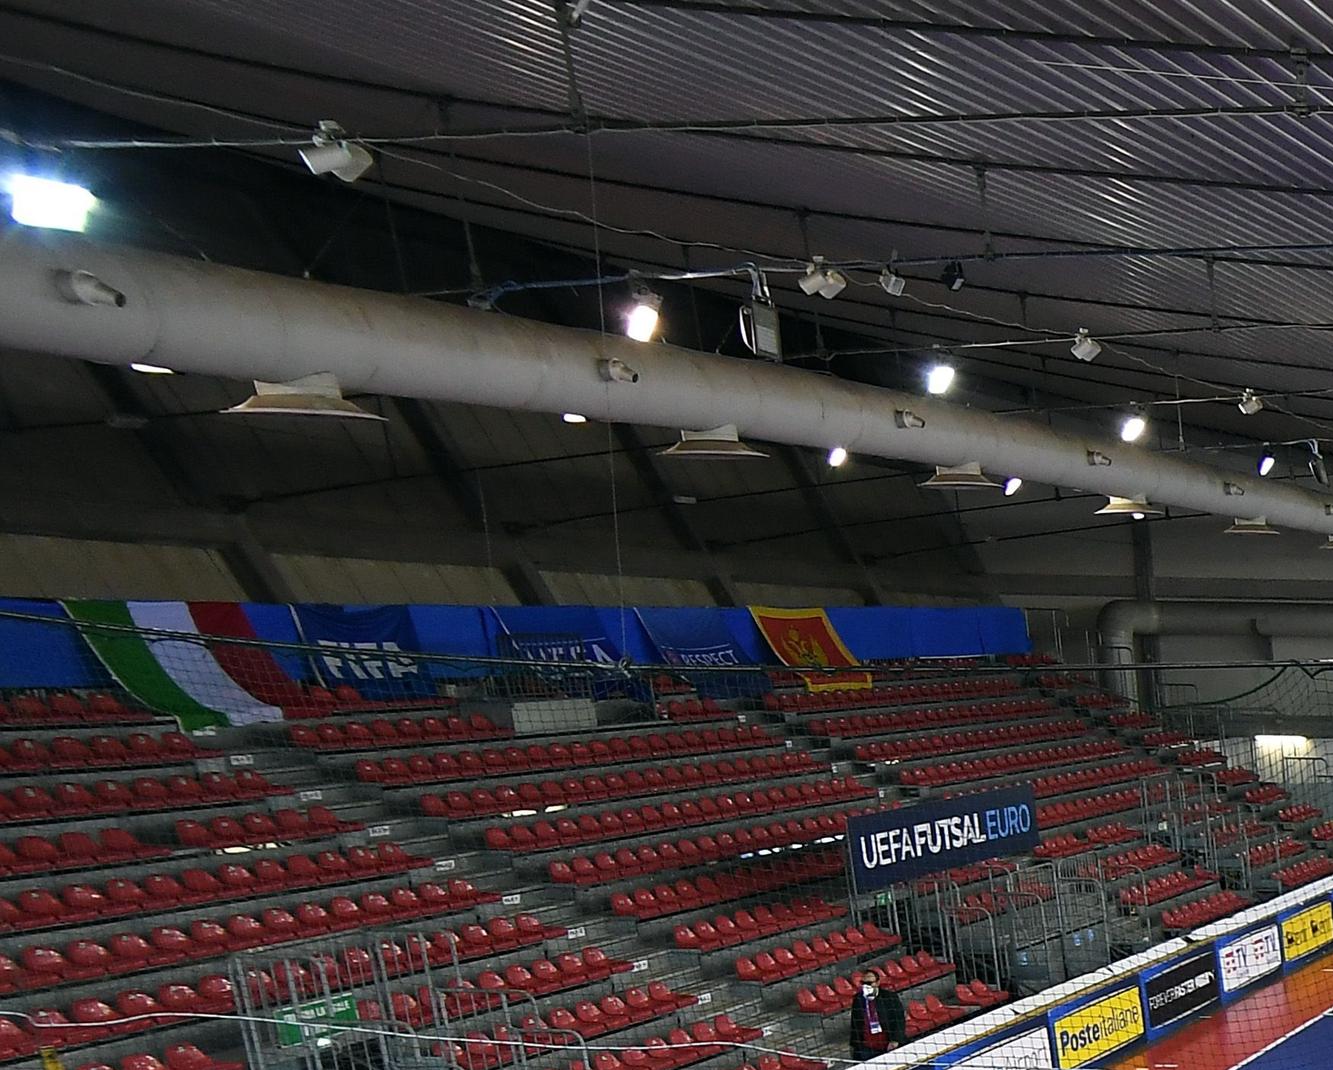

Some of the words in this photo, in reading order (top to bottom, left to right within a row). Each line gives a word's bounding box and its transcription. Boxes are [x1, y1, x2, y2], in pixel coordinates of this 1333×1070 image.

[317, 640, 418, 679] FIFA
[860, 827, 916, 869] UEFA
[914, 812, 986, 857] FUTSAL
[985, 803, 1031, 841] EURO
